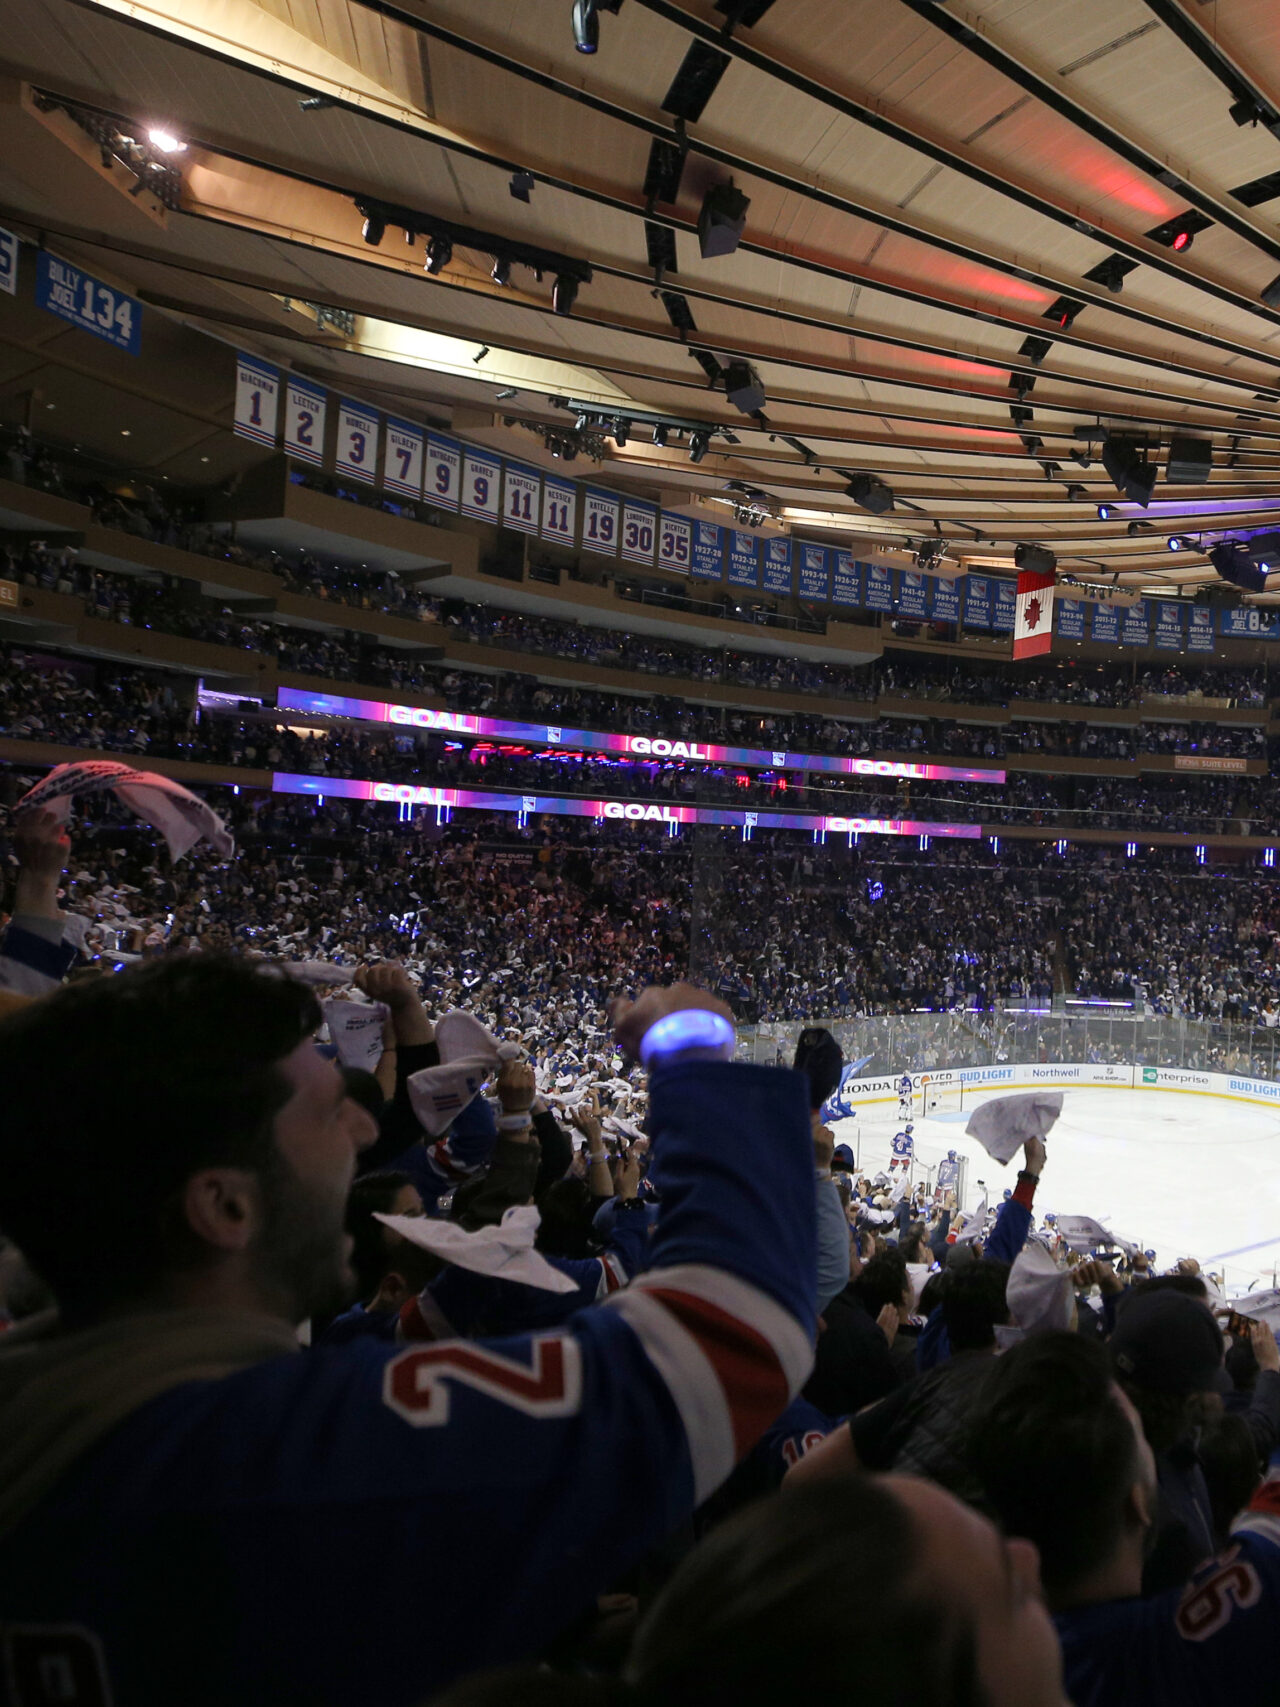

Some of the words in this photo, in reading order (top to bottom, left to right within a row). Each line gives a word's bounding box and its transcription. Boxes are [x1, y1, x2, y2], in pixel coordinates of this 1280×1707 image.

[48, 260, 80, 291] BILLY
[50, 283, 77, 312] JOEL
[81, 280, 132, 339] 134
[240, 372, 273, 393] GIACOMIN
[250, 391, 261, 426] 1
[293, 394, 320, 413] LEETCH
[297, 411, 313, 446] 2
[346, 416, 371, 434] HOWELL
[349, 432, 365, 464] 3
[391, 434, 417, 451] GILBERT
[396, 448, 412, 479] 7
[430, 449, 456, 466] BATHGATE
[435, 464, 449, 493] 9
[470, 463, 493, 478] GRAVES
[473, 477, 488, 506] 9
[509, 477, 536, 492] HADFIELD
[511, 489, 531, 521] 11
[548, 491, 571, 504] MESSIER
[548, 502, 568, 532] 11
[590, 502, 614, 515] RATELLE
[588, 512, 614, 542] 19
[626, 512, 653, 525] LUNDQVIST
[625, 522, 652, 552] 30
[665, 523, 687, 535] RICHTER
[661, 532, 688, 562] 35
[695, 545, 721, 558] 1927-28
[696, 555, 718, 564] STANLEY
[692, 567, 721, 578] CHAMPIONS
[729, 575, 757, 586] CHAMPIONS
[802, 570, 828, 580] 1993-94
[764, 582, 791, 592] CHAMPIONS
[803, 579, 824, 587] STANLEY
[800, 589, 827, 599] CHAMPIONS
[995, 603, 1016, 611] 1991-9
[390, 706, 474, 733] GOAL
[630, 737, 704, 759] GOAL
[854, 760, 925, 778] GOAL
[374, 784, 452, 805] GOAL
[604, 803, 678, 822] GOAL
[829, 817, 899, 834] GOAL
[960, 1072, 983, 1083] BUD
[985, 1068, 1013, 1080] LIGHT
[1032, 1067, 1080, 1078] Northwell
[842, 1081, 891, 1094] HONDA
[1230, 1079, 1253, 1094] BUD
[384, 1328, 582, 1427] 2
